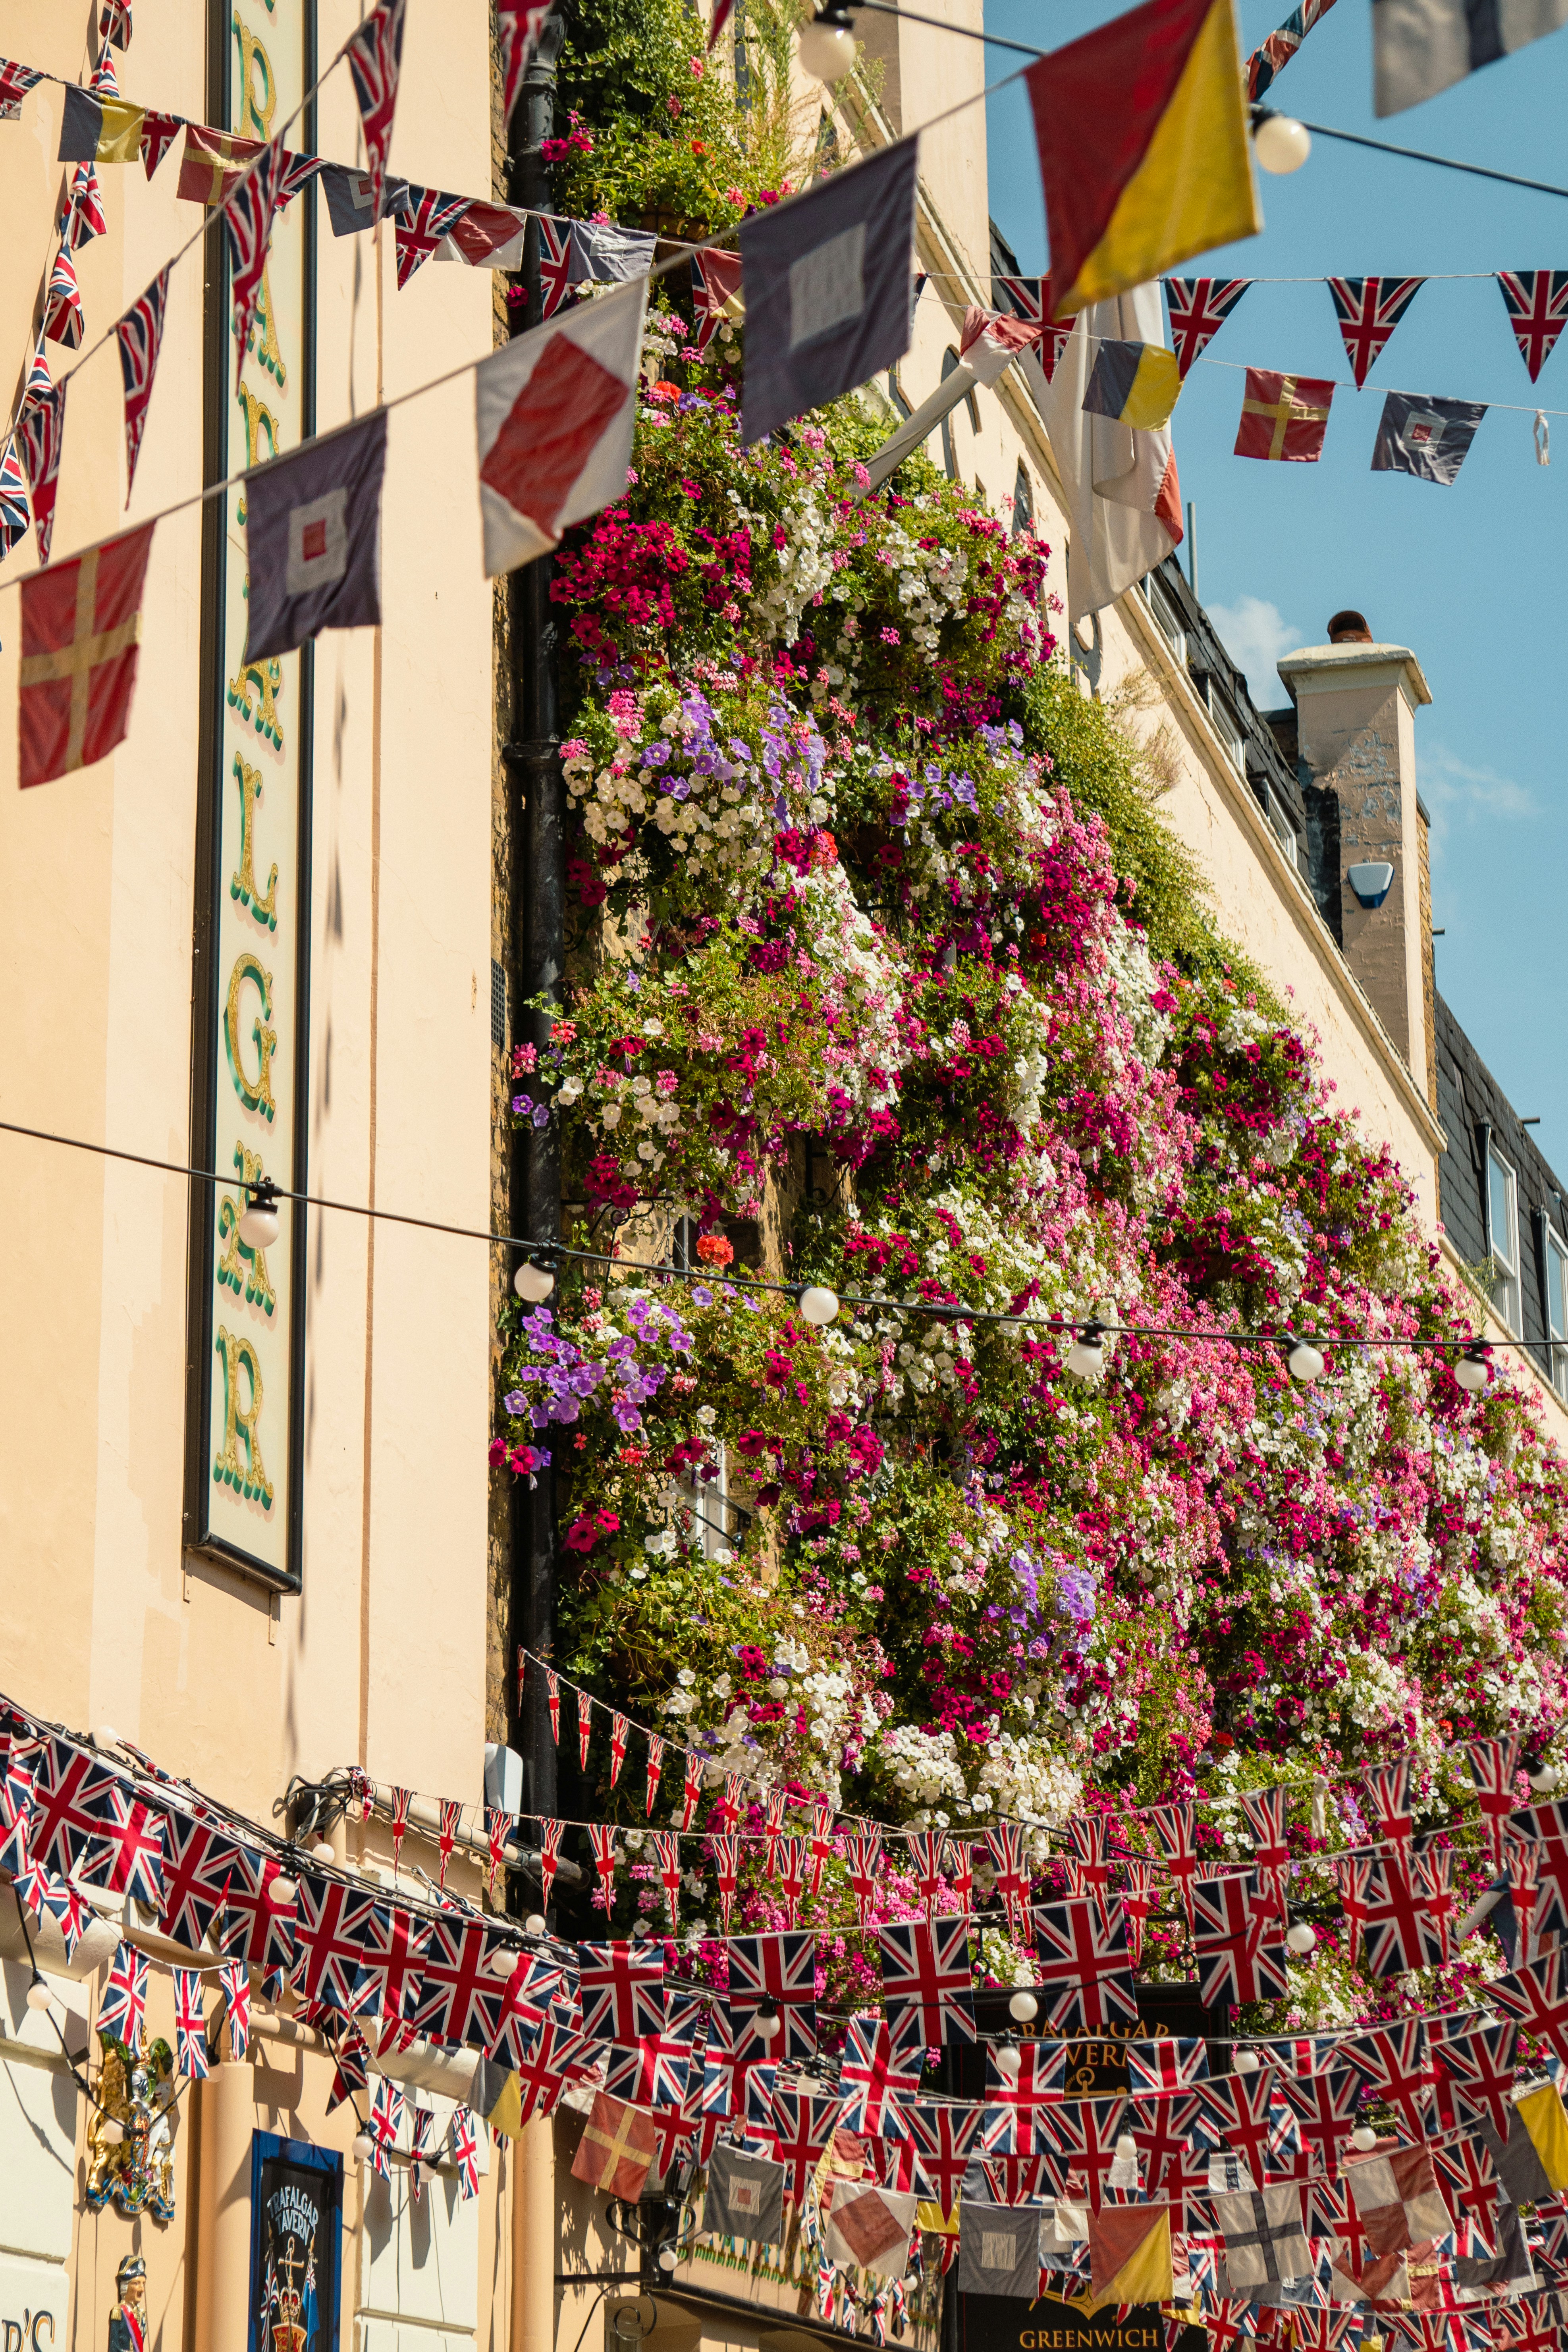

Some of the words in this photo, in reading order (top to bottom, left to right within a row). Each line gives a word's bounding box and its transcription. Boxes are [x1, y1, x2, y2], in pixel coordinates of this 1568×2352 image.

[213, 0, 287, 1511] RFLGAR
[999, 2019, 1169, 2039] RAALGAR
[1066, 2043, 1127, 2067] VER
[267, 2185, 319, 2234] TRAFALGAR
[275, 2209, 310, 2246] TAVERN
[1019, 2329, 1159, 2348] GREENWICH
